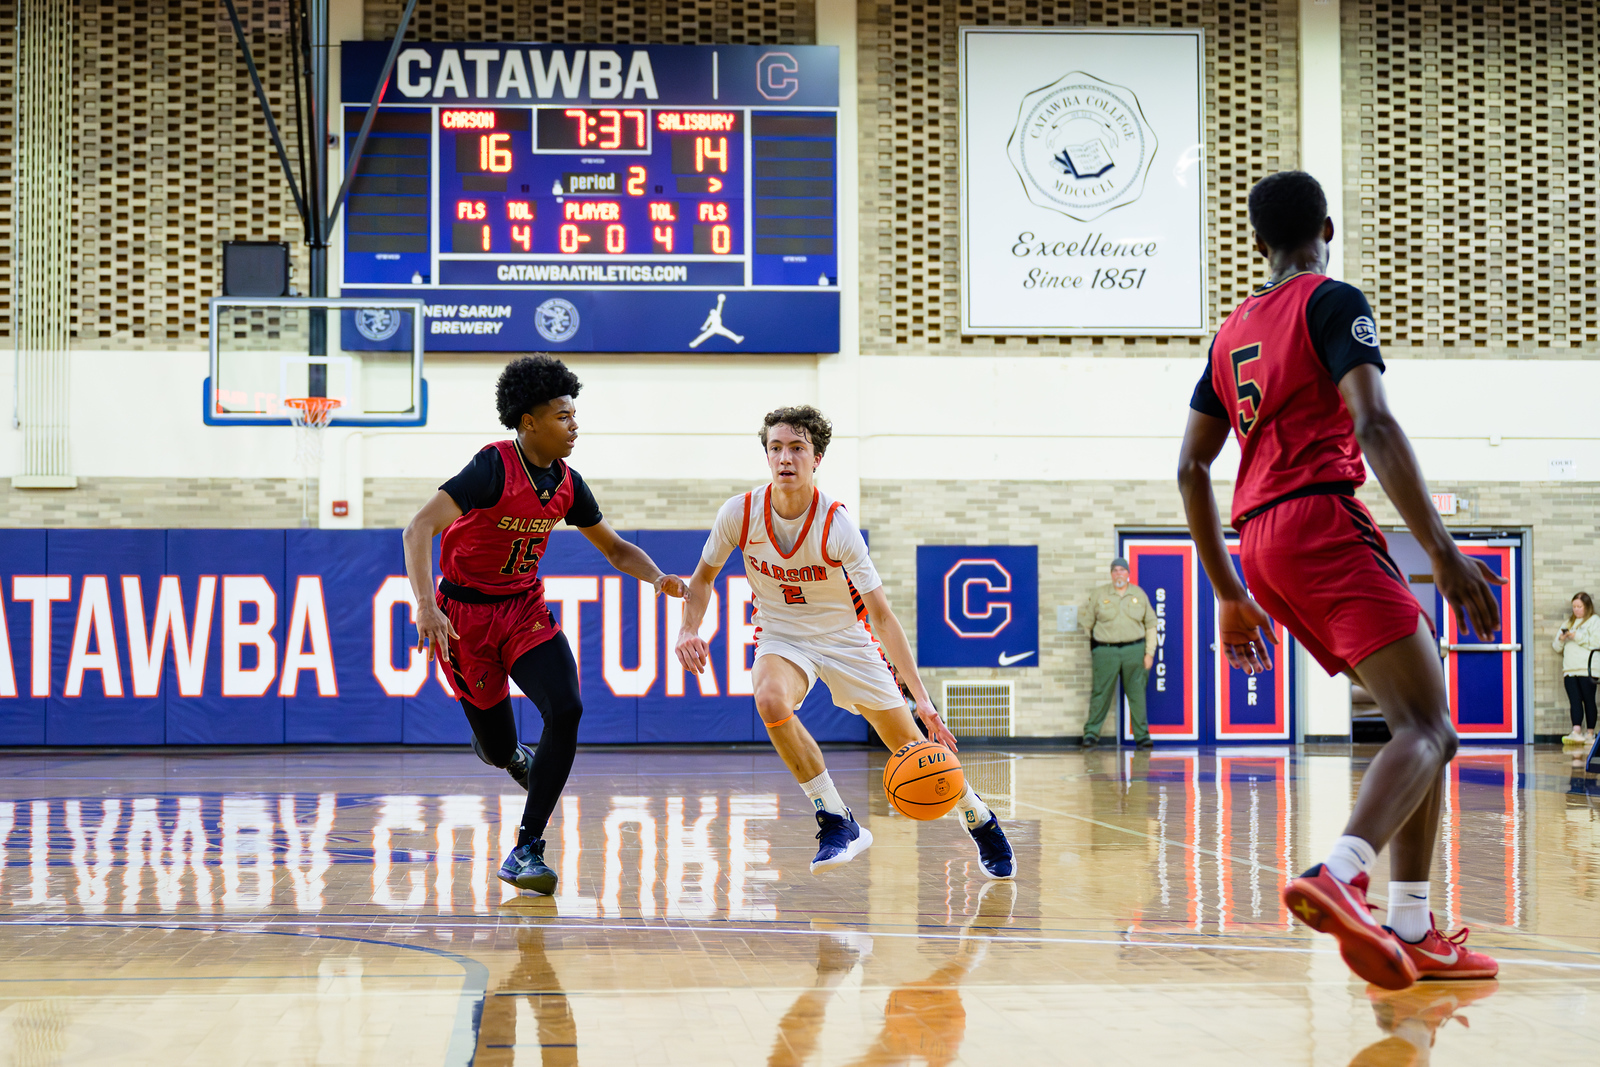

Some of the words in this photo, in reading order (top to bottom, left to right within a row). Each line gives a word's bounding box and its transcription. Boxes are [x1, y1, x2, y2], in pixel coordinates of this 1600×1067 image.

[396, 48, 659, 99] CATAWBA
[442, 110, 495, 129] CARSON
[565, 108, 645, 149] 7:37
[657, 112, 735, 131] SALISBURY
[1029, 94, 1081, 139] CATAWBA
[1085, 94, 1136, 141] COLLEGE
[480, 133, 512, 173] 16
[695, 136, 728, 173] 14
[570, 172, 616, 193] period
[627, 166, 647, 196] 2
[457, 201, 487, 220] FLS
[507, 201, 534, 220] TOL
[565, 202, 620, 221] PLAYER
[649, 203, 677, 221] TOL
[699, 203, 728, 221] FLS
[512, 224, 531, 252] 4
[654, 225, 673, 253] 4
[711, 225, 731, 254] 0
[1011, 231, 1158, 257] Excellence
[497, 264, 688, 282] CATAWBAATHLETICS.COM
[1023, 267, 1083, 290] Since
[1091, 267, 1147, 290] 1851
[422, 304, 458, 318] NEW
[458, 304, 512, 319] SARUM
[430, 320, 504, 335] BREWERY
[1230, 341, 1264, 439] 5
[1431, 495, 1453, 511] EXIT
[499, 536, 546, 575] 15
[748, 555, 829, 583] CARSON
[779, 584, 808, 605] 2
[944, 559, 1012, 638] C
[1155, 587, 1167, 692] SERVICE
